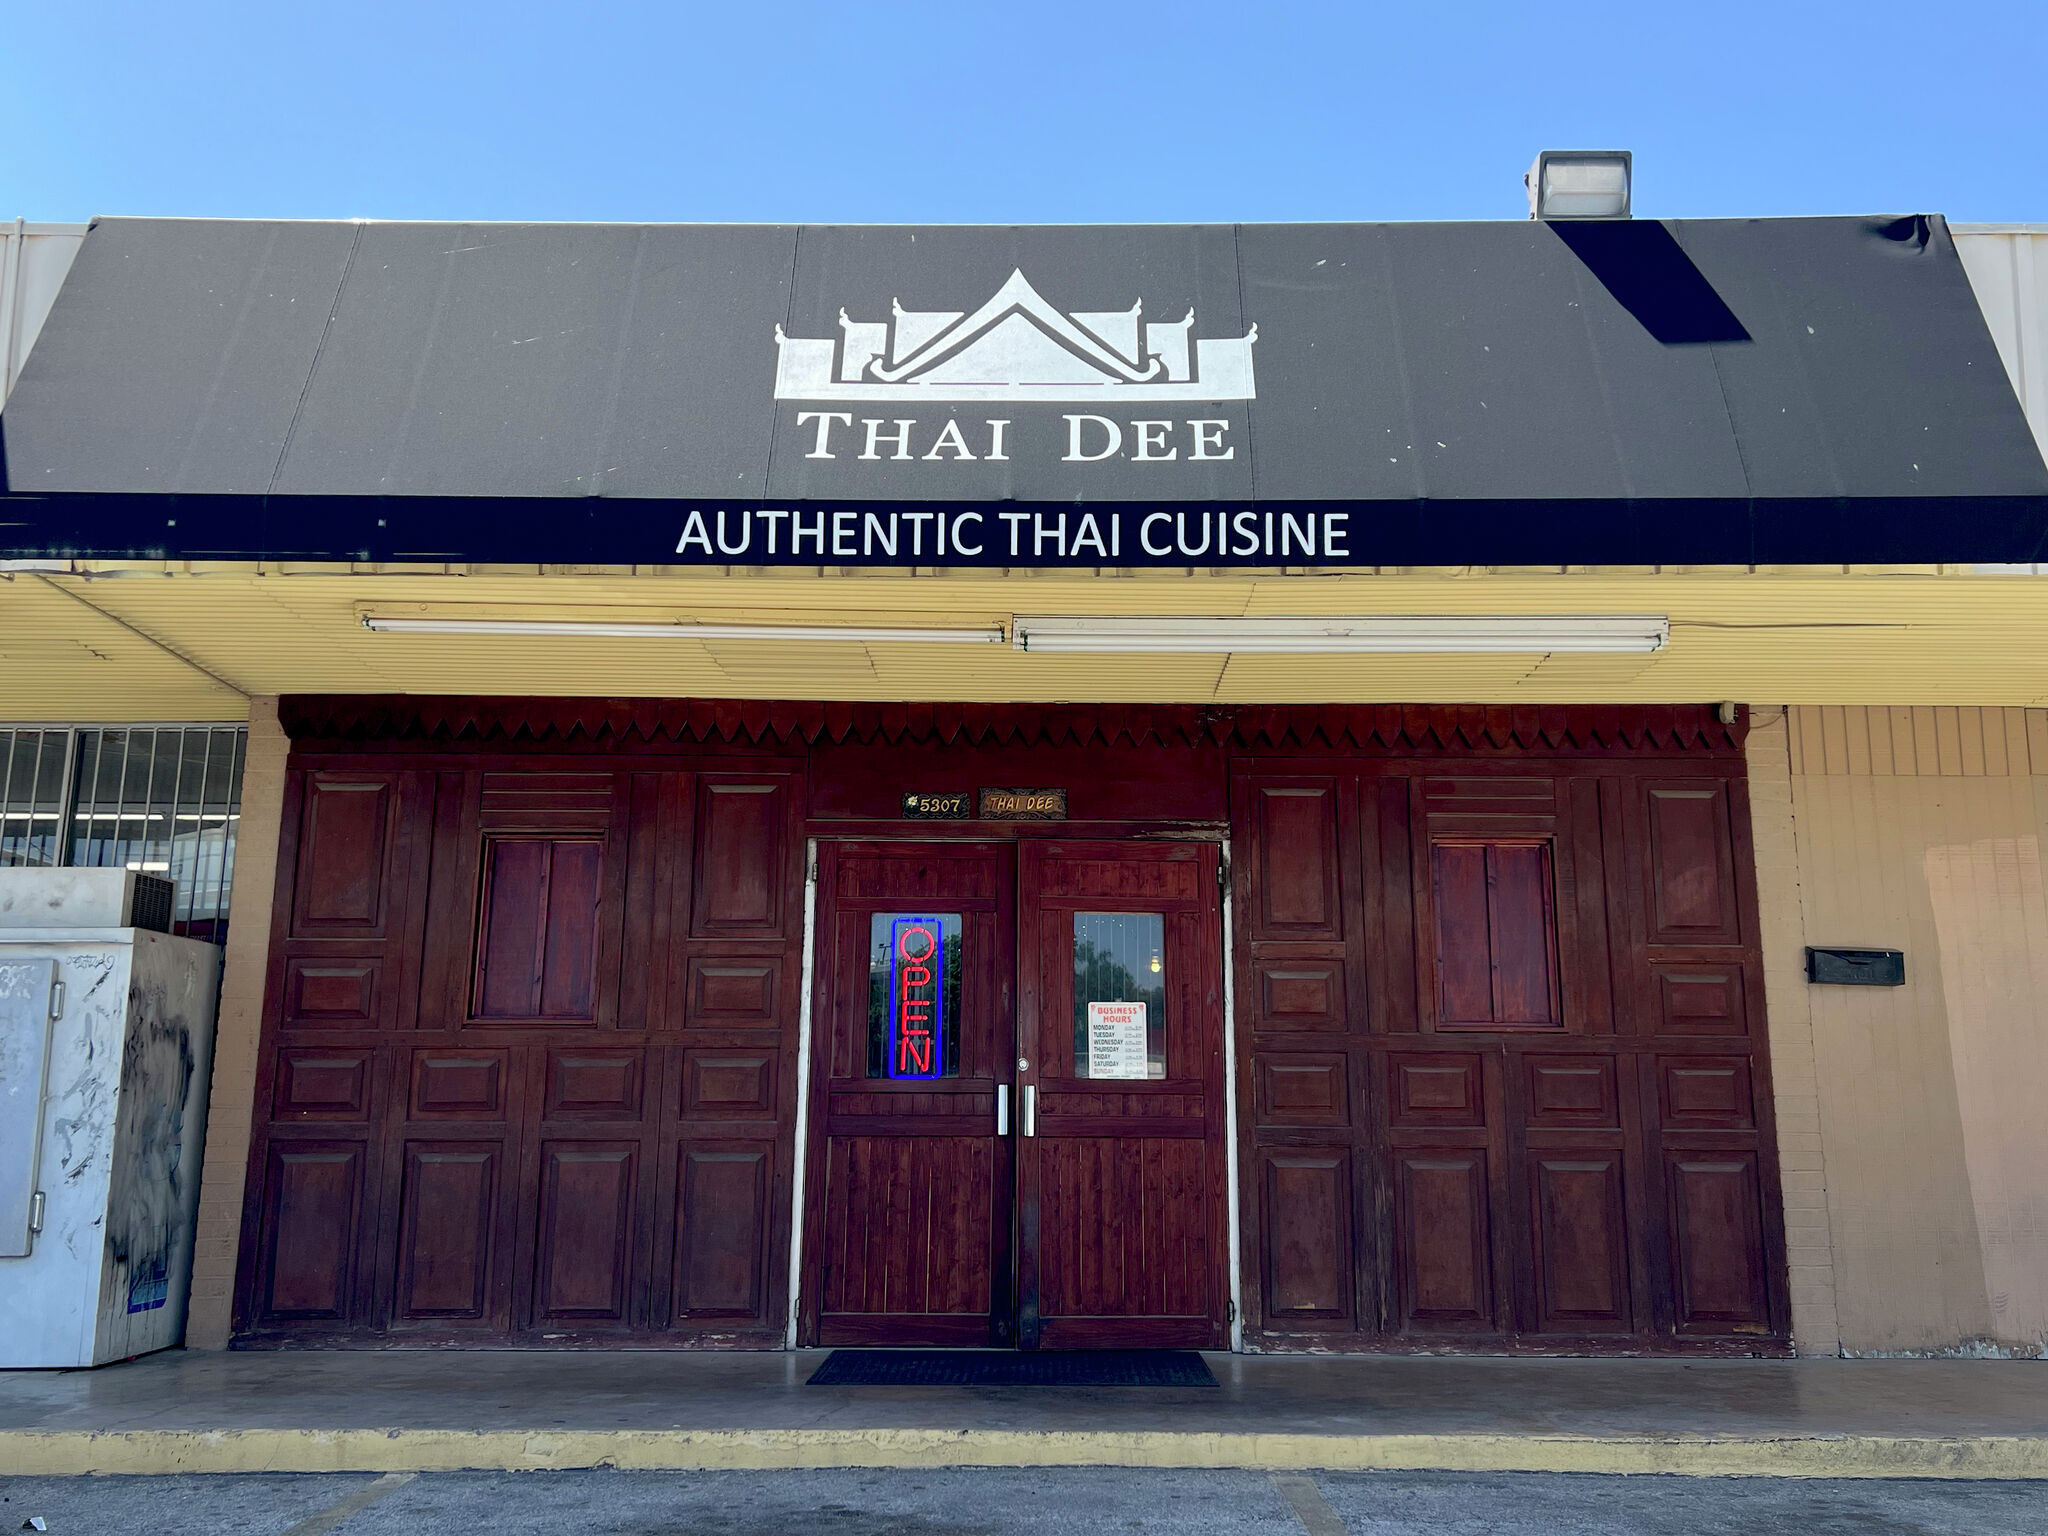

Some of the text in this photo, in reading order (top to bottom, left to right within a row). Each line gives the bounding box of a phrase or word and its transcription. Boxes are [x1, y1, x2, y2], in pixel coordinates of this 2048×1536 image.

[795, 411, 1235, 462] THAI DEE
[675, 509, 1350, 557] AUTHENTIC THAI CUISINE
[919, 799, 960, 812] 5307
[991, 797, 1054, 810] THAI DEE
[899, 927, 935, 1072] OPEN
